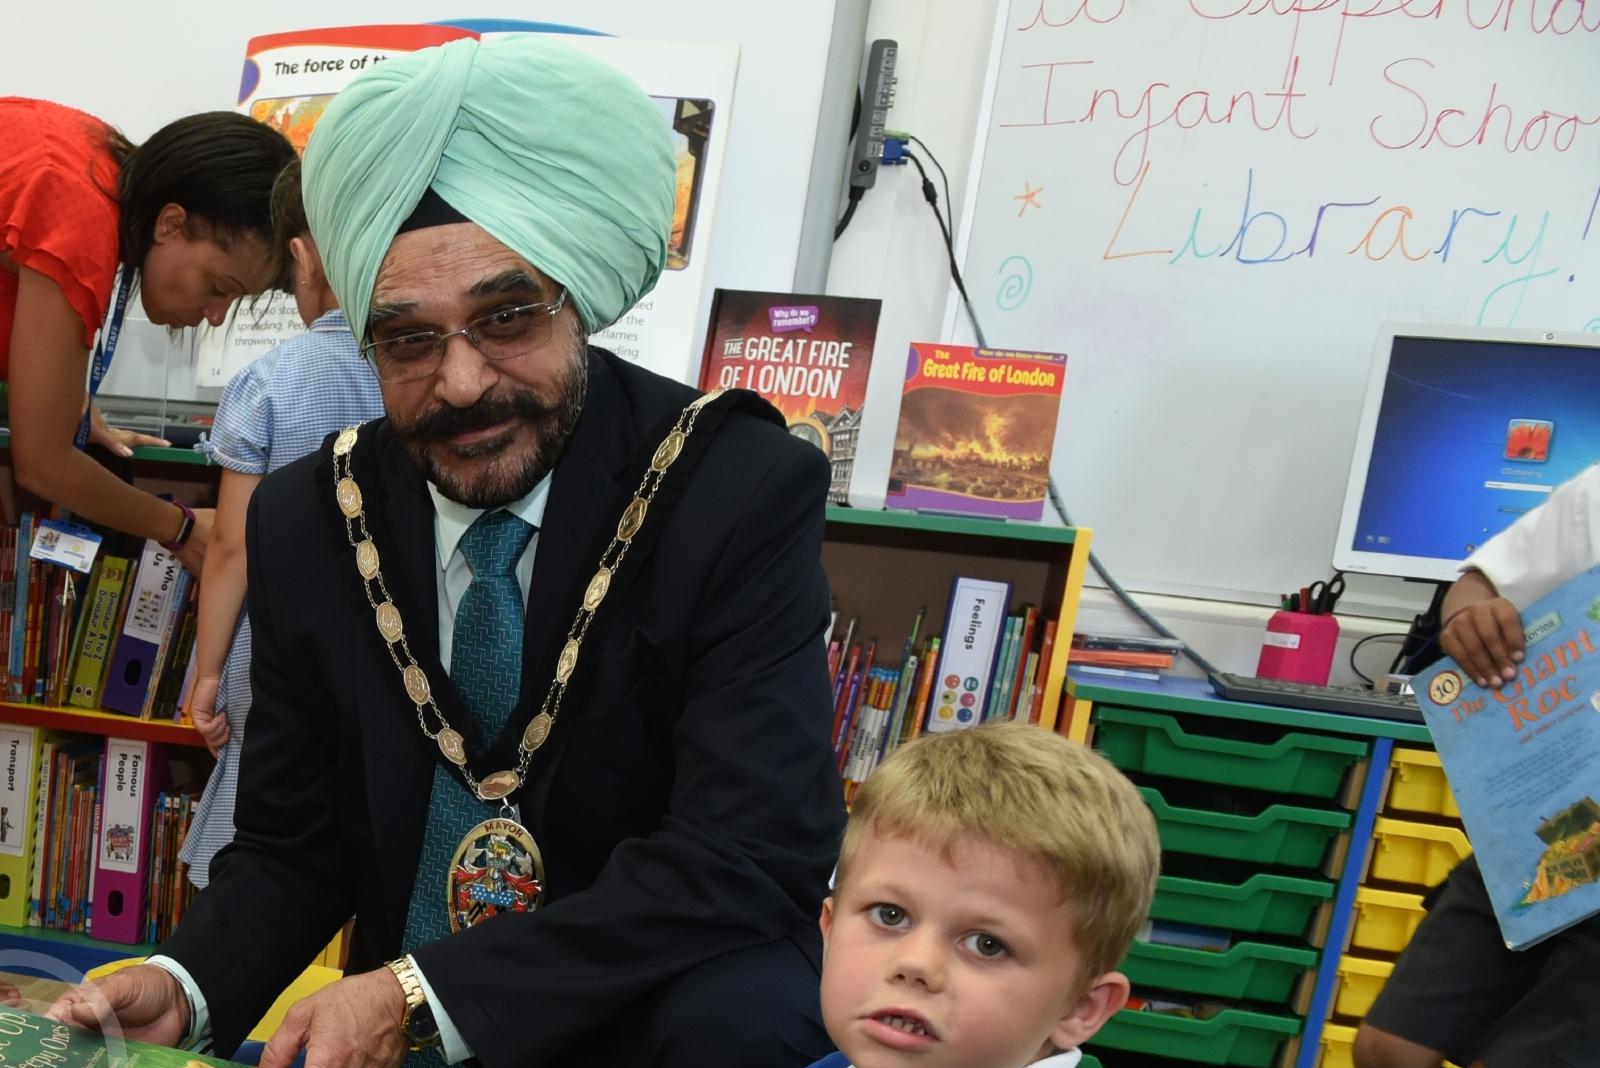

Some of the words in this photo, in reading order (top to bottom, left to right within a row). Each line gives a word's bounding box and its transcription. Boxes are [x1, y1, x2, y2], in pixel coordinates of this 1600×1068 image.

[274, 62, 299, 76] The
[303, 58, 345, 74] force
[349, 55, 369, 71] of
[1000, 56, 1318, 186] Infant
[1370, 57, 1600, 153] Schoo
[723, 341, 744, 356] THE
[744, 337, 807, 365] GREAT
[807, 340, 853, 368] FIRE
[934, 350, 950, 360] The
[719, 365, 744, 389] OF
[746, 365, 842, 399] LONDON
[923, 359, 960, 379] Great
[961, 362, 986, 382] Fire
[989, 364, 1006, 383] of
[1006, 366, 1056, 387] London
[152, 552, 165, 567] Us
[161, 563, 176, 592] Who
[89, 589, 107, 628] Dinosaur
[102, 592, 118, 629] Dinosaur
[963, 598, 986, 650] Feelings
[1435, 678, 1456, 700] 10
[1507, 674, 1579, 732] Roc
[1452, 694, 1489, 723] The
[8, 739, 20, 792] Transport
[116, 753, 128, 792] People
[129, 754, 142, 798] Famous
[484, 821, 524, 838] MAYOR
[39, 1023, 71, 1050] Ones
